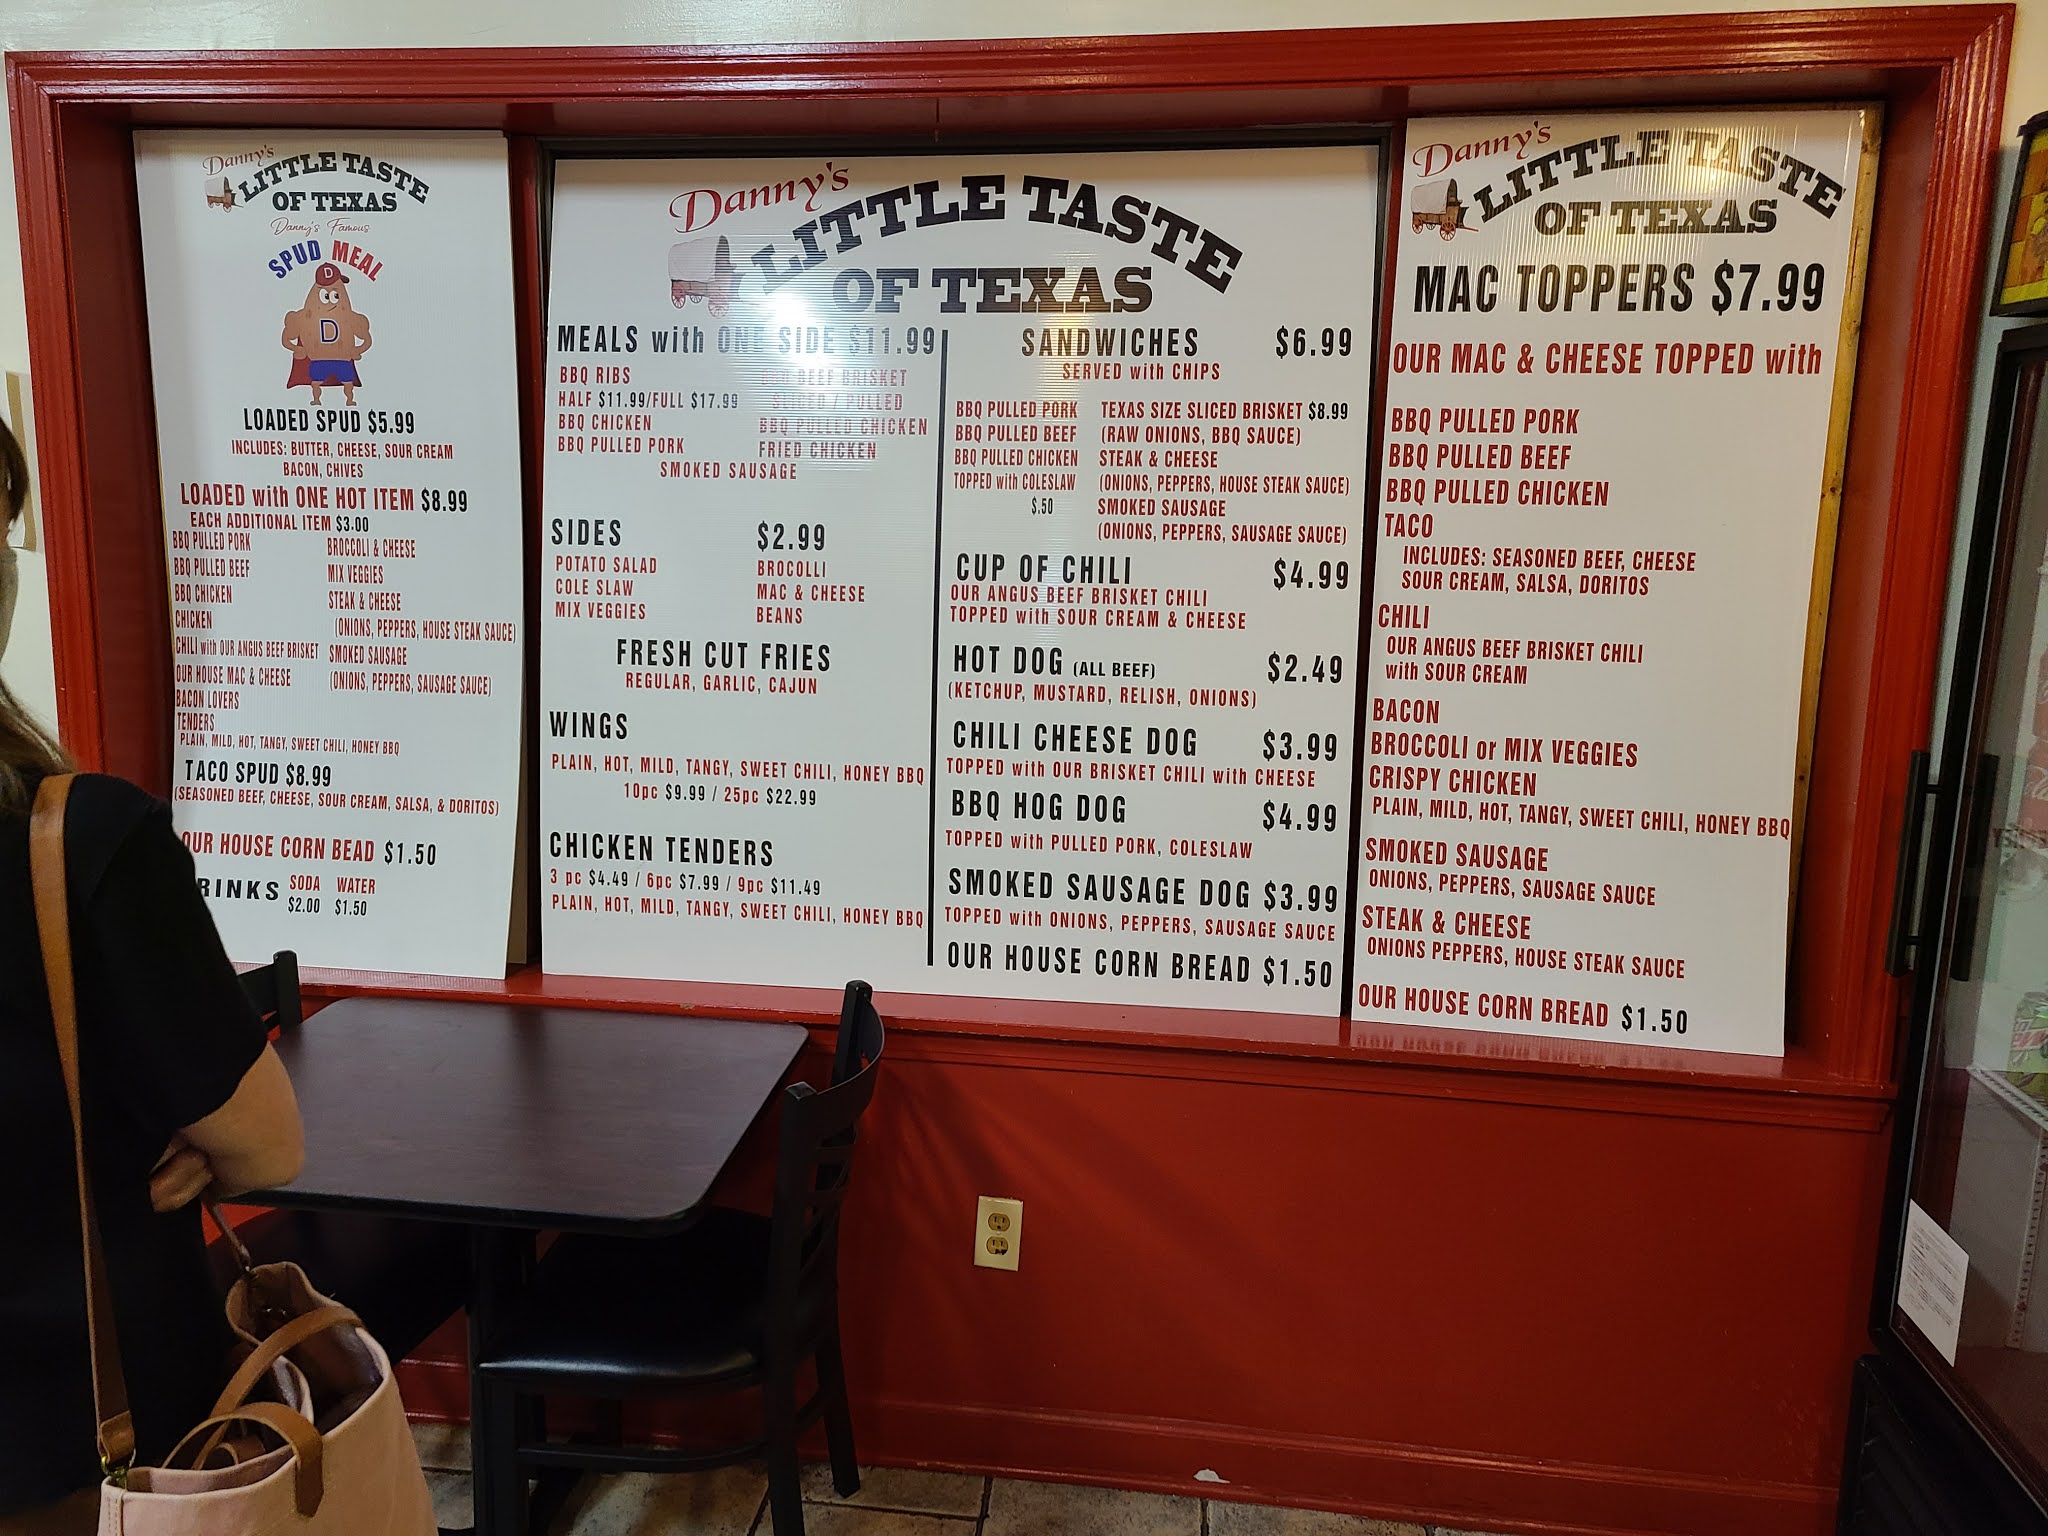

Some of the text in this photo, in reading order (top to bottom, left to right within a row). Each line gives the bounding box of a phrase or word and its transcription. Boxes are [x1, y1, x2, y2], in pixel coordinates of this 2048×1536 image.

[203, 145, 274, 175] Danny's
[1412, 121, 1551, 178] Danny's
[238, 151, 430, 204] LITTLE TASTE
[1473, 129, 1846, 223] LITTLE TASTE
[273, 192, 397, 212] OF TEXAS
[669, 162, 849, 233] Danny's
[271, 217, 370, 237] Danny's Famous
[1535, 199, 1777, 235] OF TEXAS
[751, 174, 1243, 294] LITTLE TASTE
[268, 240, 383, 282] SPUD MEAL
[324, 267, 334, 278] D
[832, 266, 1153, 313] OF TEXAS
[1414, 259, 1825, 316] MAC TOPPERS $7.99
[320, 319, 339, 343] D
[558, 325, 704, 353] MEALS with
[1022, 325, 1352, 359] SANDWICHES $6.99
[1062, 362, 1219, 380] SERVED with CHIPS
[1394, 343, 1821, 374] OUR MAC & CHEESE TOPPED with
[560, 366, 630, 385] BBQ RIBS
[559, 391, 591, 407] HALF
[691, 391, 737, 409] $17.99
[244, 408, 414, 435] LOADED SPUD $5.99
[1392, 408, 1579, 435] BBQ PULLED PORK
[232, 440, 453, 459] INCLUDES: BUTTER, CHEESE, SOUR CREAM
[661, 461, 796, 479] SMOKED SAUSAGE
[181, 483, 467, 513] LOADED with ONE HOT ITEM $8.99
[1100, 474, 1349, 496] (ONIONS, PEPPERS, HOUSE STEAK SAUCE)
[552, 518, 824, 552] SIDES $2.99
[1385, 513, 1433, 538] TACO
[173, 531, 250, 551] BBQ PULLED PORK
[328, 538, 415, 558] BROCCOLI & CHEESE
[556, 556, 656, 573] POTATO SALAD
[758, 560, 825, 577] BROCOLLI
[957, 553, 1348, 590] CUP OF CHILI $4.99
[757, 583, 864, 602] MAC & CHEESE
[1379, 604, 1429, 629] CHILI
[335, 618, 515, 643] (ONIONS, PEPPERS, HOUSE STEAK SAUCE)
[618, 639, 829, 671] FRESH CUT FRIES
[954, 645, 1342, 684] HOT DOG (ALL BEEF) $2.49
[626, 672, 816, 694] REGULAR, GARLIC, CAJUN
[949, 682, 1256, 709] (KETCHUP, MUSTARD, RELISH, ONIONS)
[1373, 698, 1439, 723] BACON
[550, 711, 627, 739] WINGS
[954, 721, 1337, 762] CHILI CHEESE DOG $3.99
[1371, 732, 1637, 767] BROCCOLI or MIX VEGGIES
[186, 760, 331, 787] TACO SPUD $8.99
[625, 783, 815, 805] 10pc $9.99 / 25pc $22.99
[952, 790, 1336, 832] BBQ HOG DOG $4.99
[181, 831, 436, 865] OUR HOUSE CORN BEAD $1.50
[550, 832, 772, 866] CHICKEN TENDERS
[1366, 838, 1548, 871] SMOKED SAUSAGE
[197, 875, 375, 901] RINKS SODA WATER
[288, 896, 366, 916] $2.00 $1.50
[948, 942, 1331, 987] OUR HOUSE CORN BREAD $1.50
[1359, 984, 1687, 1034] OUR HOUSE CORN BREAD $1.50
